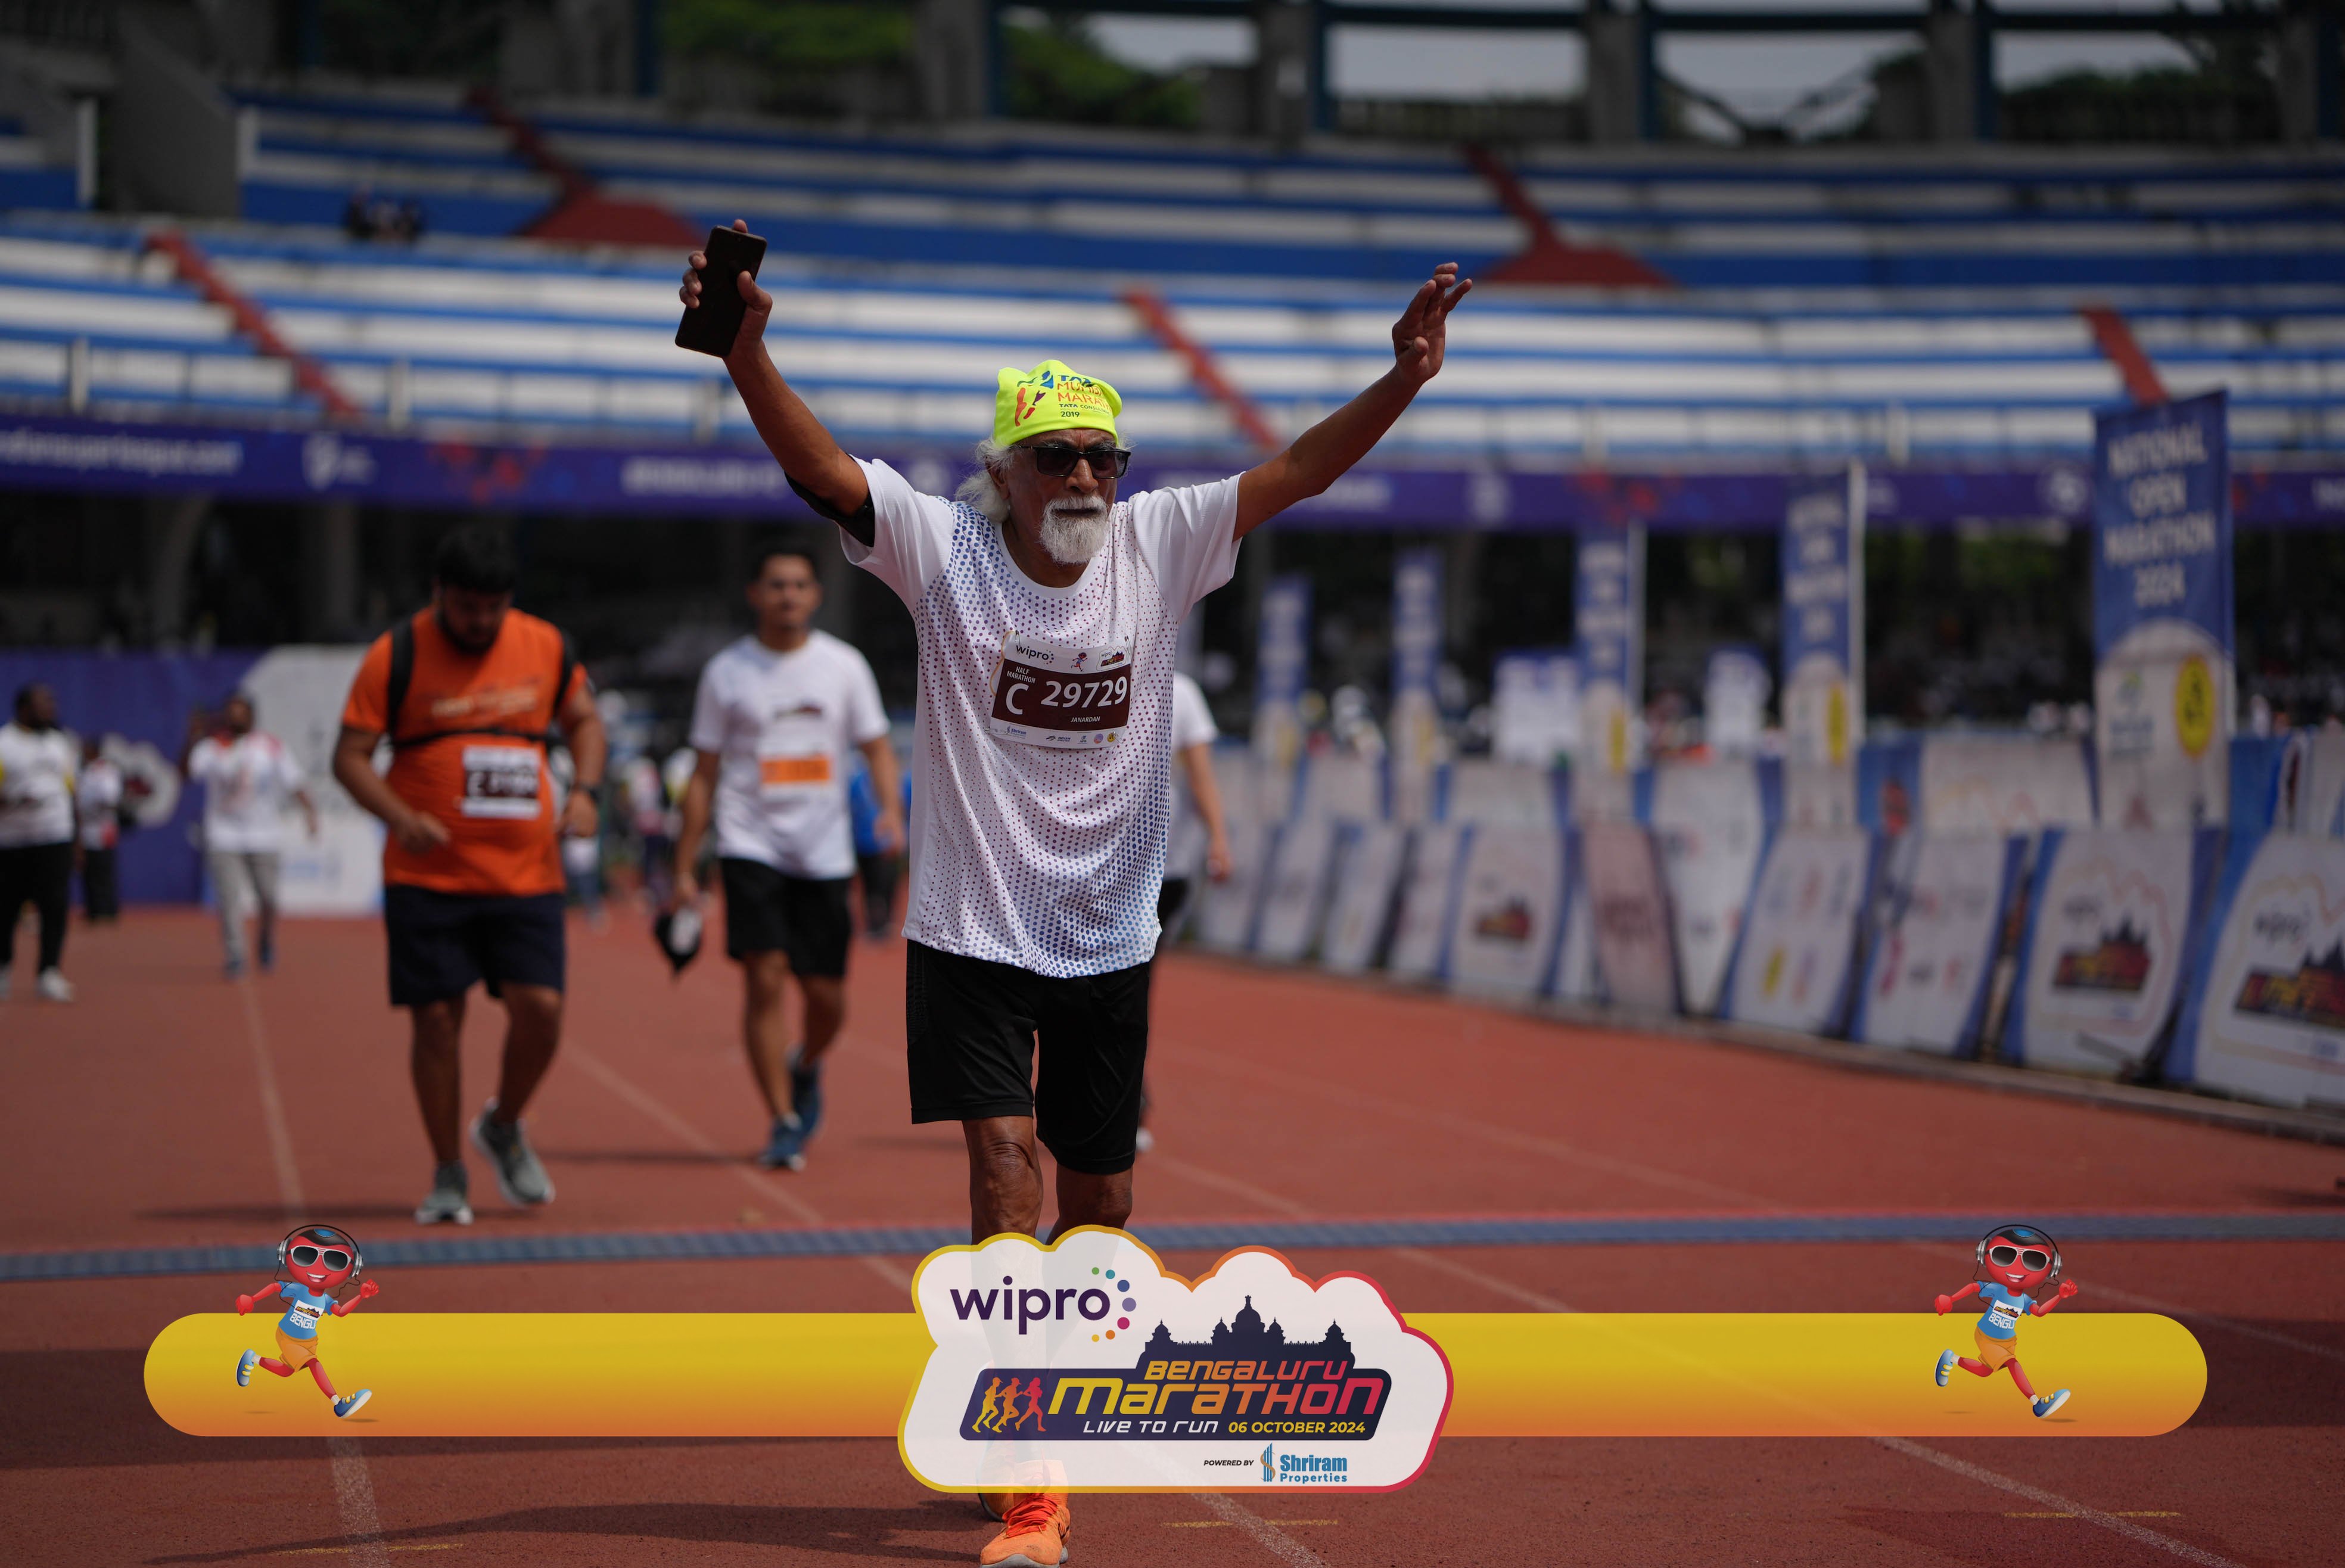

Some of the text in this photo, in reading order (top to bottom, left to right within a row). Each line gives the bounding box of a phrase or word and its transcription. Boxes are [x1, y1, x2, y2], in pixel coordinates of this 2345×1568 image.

[1016, 645, 1049, 661] wipro
[1007, 671, 1036, 684] MARATHON
[1016, 667, 1030, 675] HALF
[1006, 676, 1128, 715] C 29729
